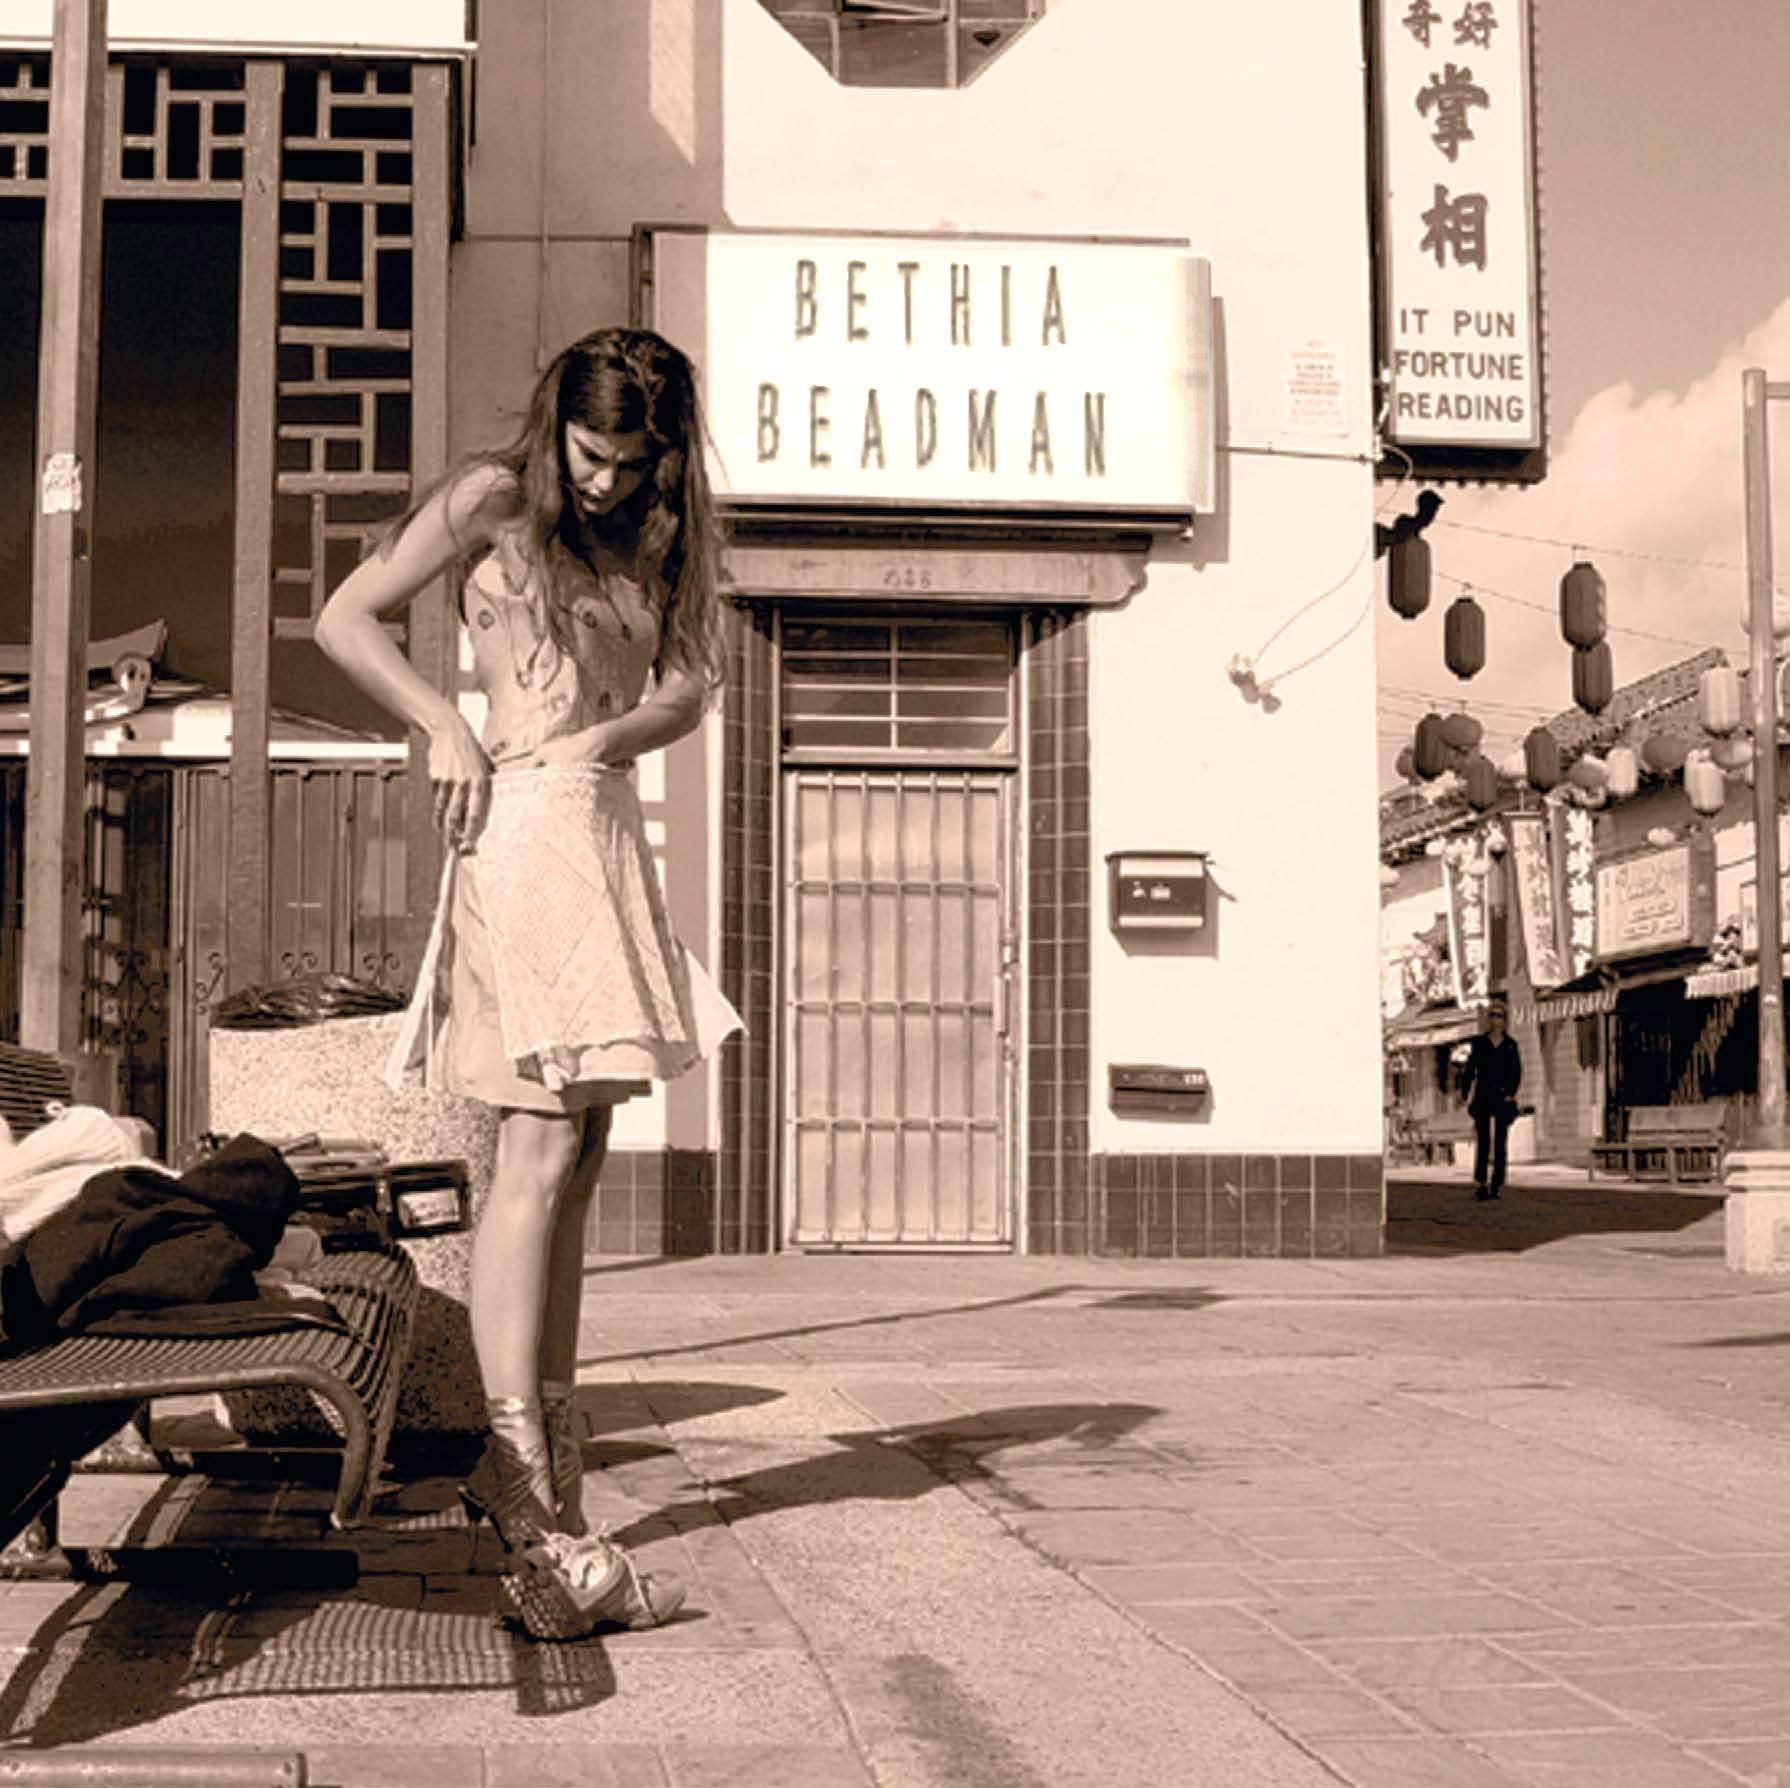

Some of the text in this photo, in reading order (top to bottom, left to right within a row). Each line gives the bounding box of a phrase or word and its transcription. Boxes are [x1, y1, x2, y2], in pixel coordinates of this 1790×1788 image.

[795, 259, 1066, 346] BETHIA
[1401, 309, 1515, 338] IT PUN
[1396, 350, 1523, 381] FORTUNE
[1398, 392, 1524, 423] READING
[757, 383, 1106, 476] BEADMAN
